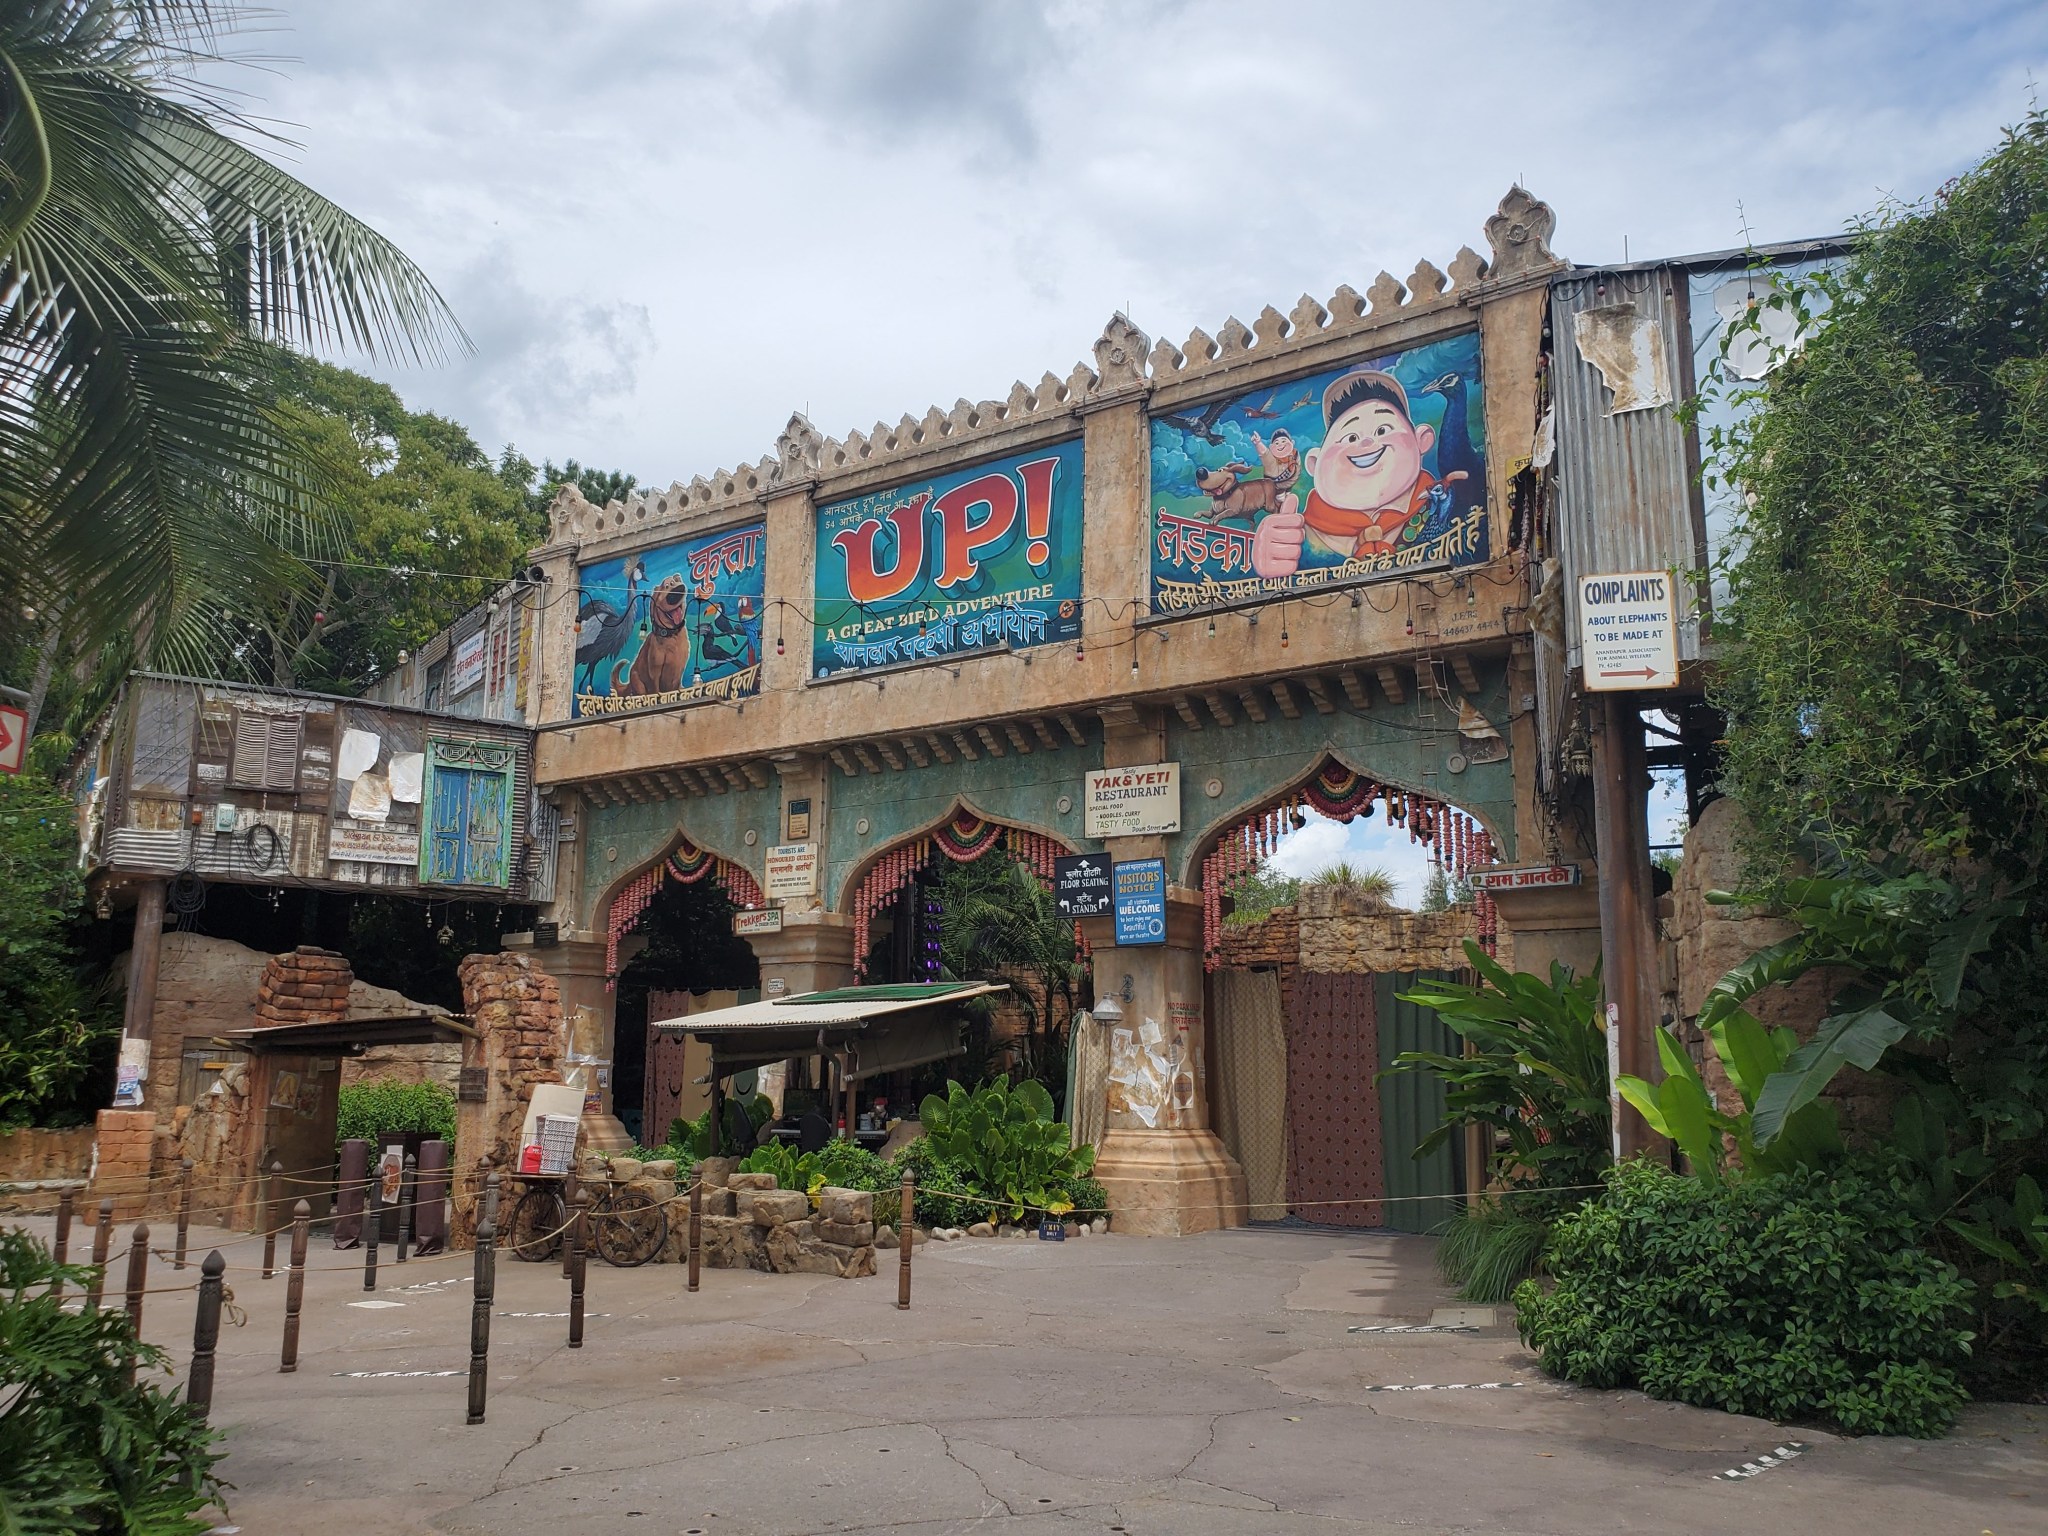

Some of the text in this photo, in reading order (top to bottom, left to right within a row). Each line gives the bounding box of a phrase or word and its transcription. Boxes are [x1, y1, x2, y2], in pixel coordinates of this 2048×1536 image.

[825, 519, 836, 530] 54
[832, 457, 1061, 603] UP!
[1376, 549, 1396, 572] के
[1395, 541, 1429, 567] पास
[1426, 516, 1467, 562] जाते
[688, 527, 764, 600] कुत्ता
[1584, 578, 1665, 605] COMPLAINTS
[826, 583, 1054, 642] A GREAT BIRD ADVENTURE
[1587, 612, 1668, 626] ABOUT ELEPHANTS
[1594, 629, 1664, 642] TO BE MADE AT
[1628, 646, 1662, 654] ASSOCIATION
[1093, 771, 1170, 790] YAK & YETI
[1095, 785, 1168, 802] RESTAURANT
[1124, 810, 1141, 818] CURRY
[1096, 818, 1141, 829] TASTY FOOD
[777, 846, 806, 856] TOURISTS ARE
[767, 853, 816, 864] HONOURED GUESTS
[1060, 877, 1109, 890] FLOOR SEATING
[1117, 871, 1160, 885] VISITORS
[1119, 883, 1155, 894] NOTICE
[1072, 903, 1098, 914] STANDS
[1119, 903, 1161, 915] WELCOME
[736, 912, 767, 929] Trekkers
[767, 911, 780, 922] SPA
